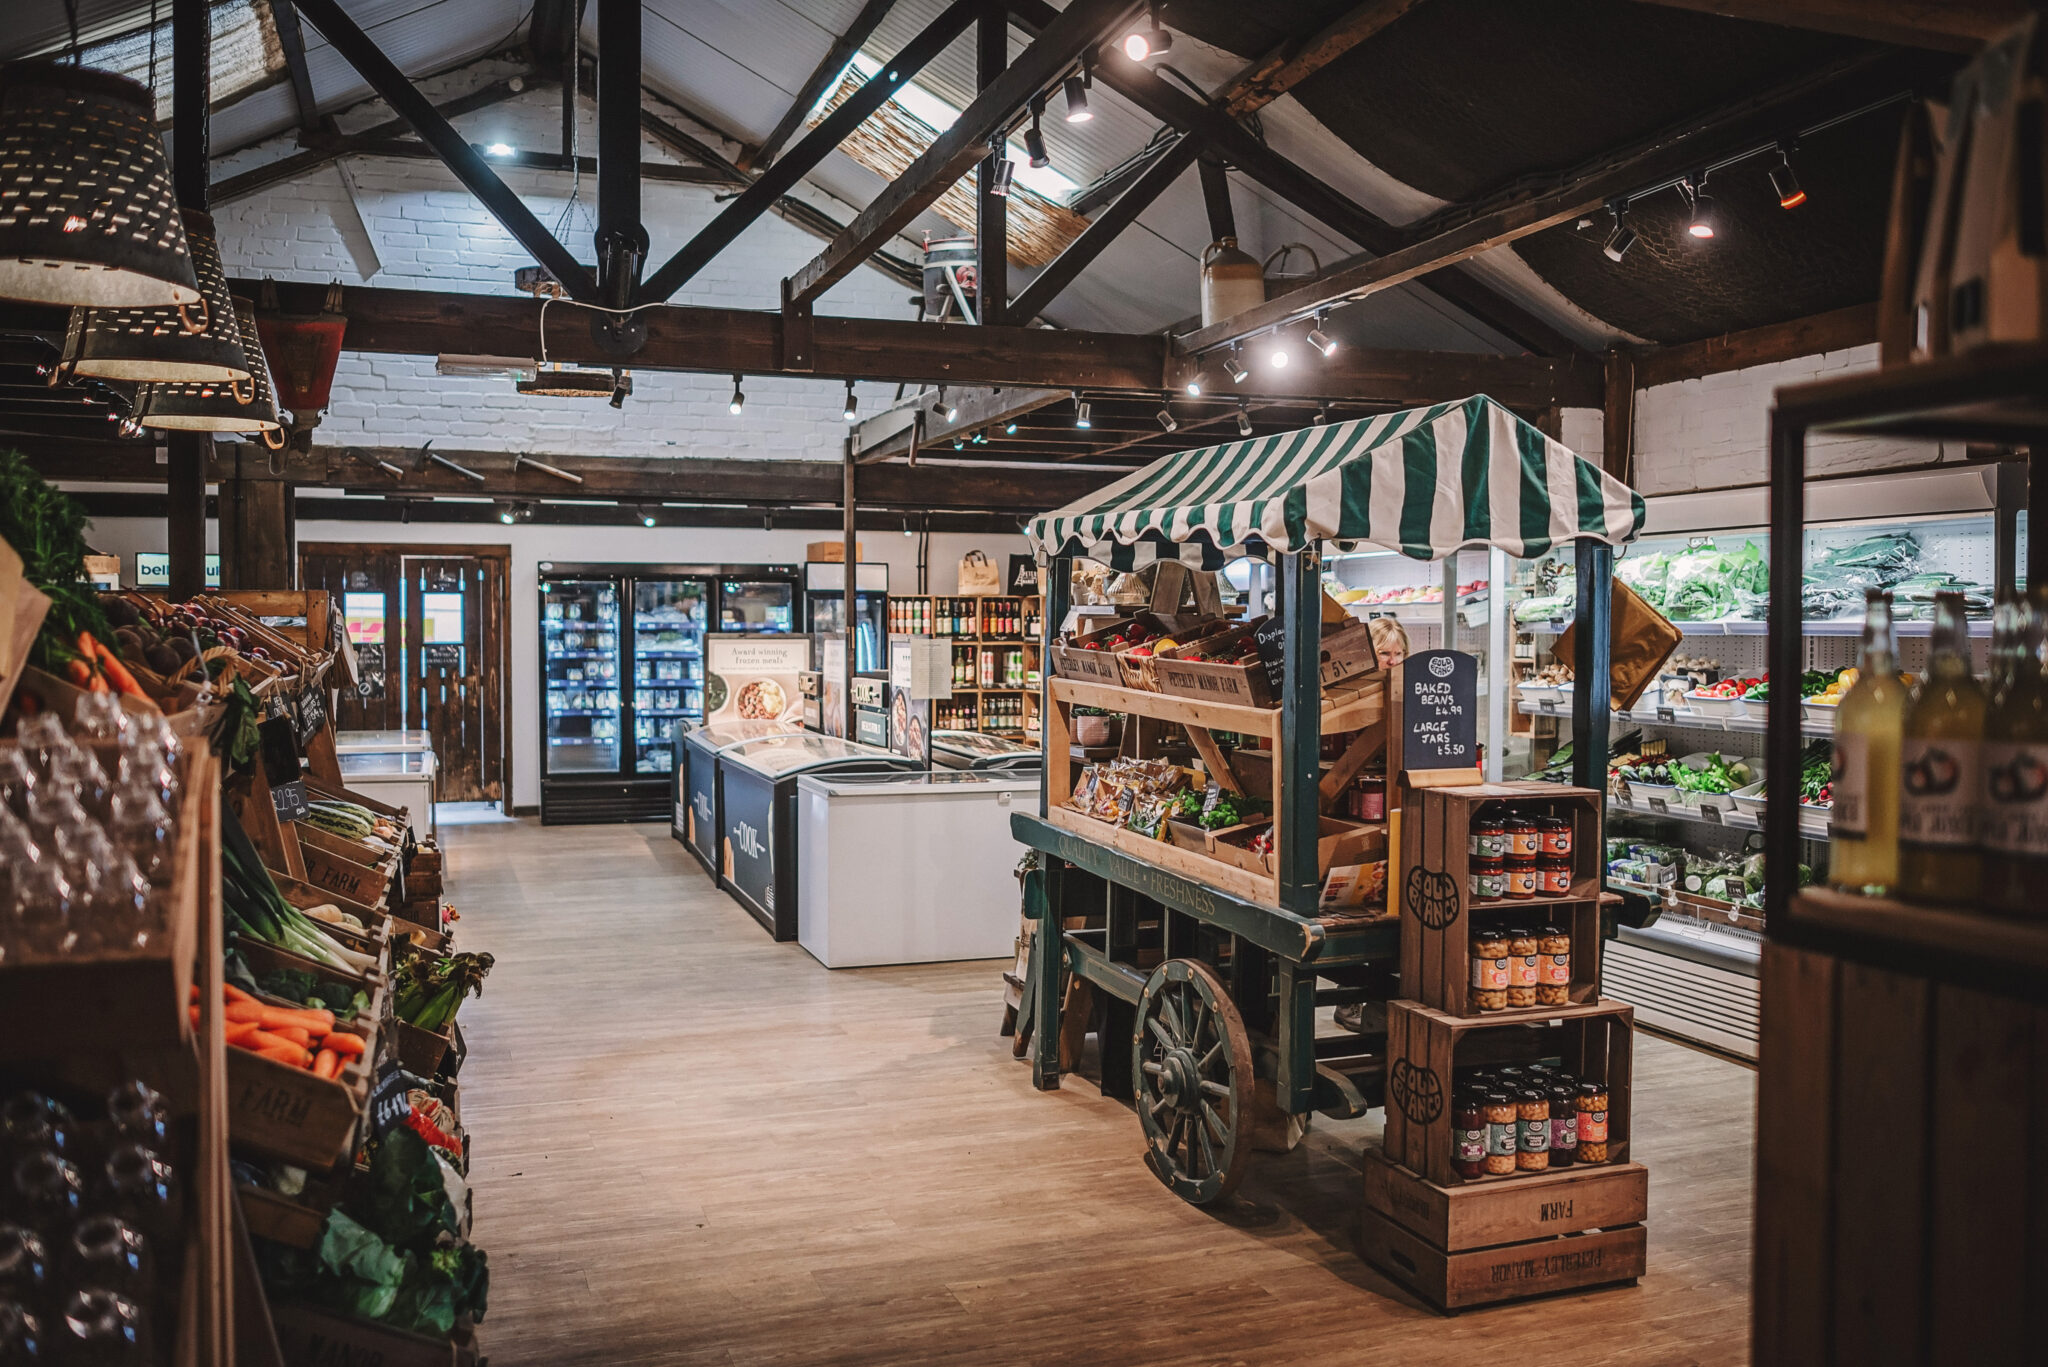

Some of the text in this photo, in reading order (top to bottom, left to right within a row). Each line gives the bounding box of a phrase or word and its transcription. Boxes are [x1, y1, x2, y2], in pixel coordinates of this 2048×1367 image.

[731, 647, 788, 658] Award winning
[1168, 671, 1239, 694] PETERLEY MANOR FARM
[1414, 682, 1452, 695] BAKED
[1421, 695, 1455, 706] BEANS
[1435, 705, 1463, 716] £4.99
[1413, 721, 1449, 733] LARGE
[1421, 732, 1450, 744] JARS
[739, 820, 758, 860] COOK
[321, 865, 361, 894] FARM
[1058, 834, 1216, 916] QUALITY VALUE FRESHNESS
[1540, 1199, 1574, 1222] FARM
[1490, 1248, 1602, 1284] PETERLEY MANOR
